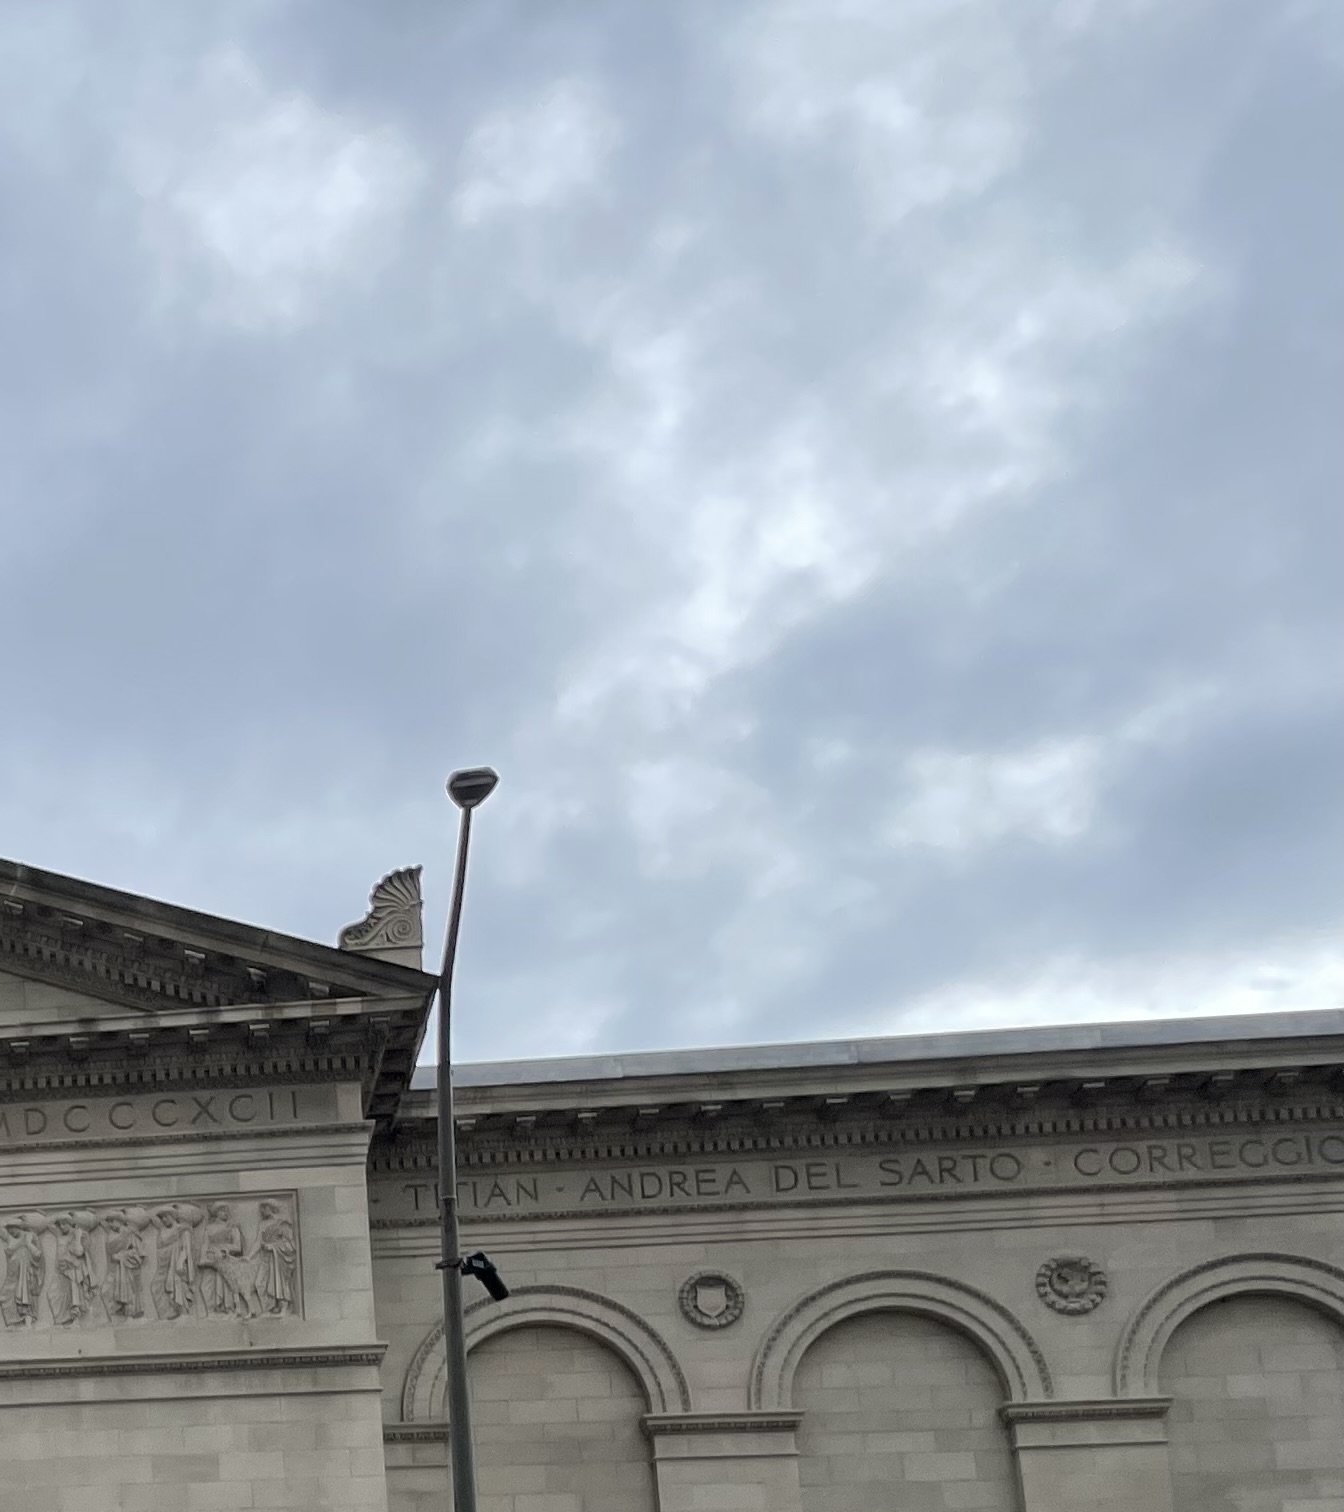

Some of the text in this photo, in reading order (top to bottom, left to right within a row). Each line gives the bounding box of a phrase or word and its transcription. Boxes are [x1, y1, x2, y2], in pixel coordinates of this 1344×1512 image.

[579, 1167, 752, 1202] ANDREA
[773, 1160, 858, 1192] DEL
[879, 1153, 1021, 1187] SARTO
[1073, 1135, 1344, 1177] CORREGGIO
